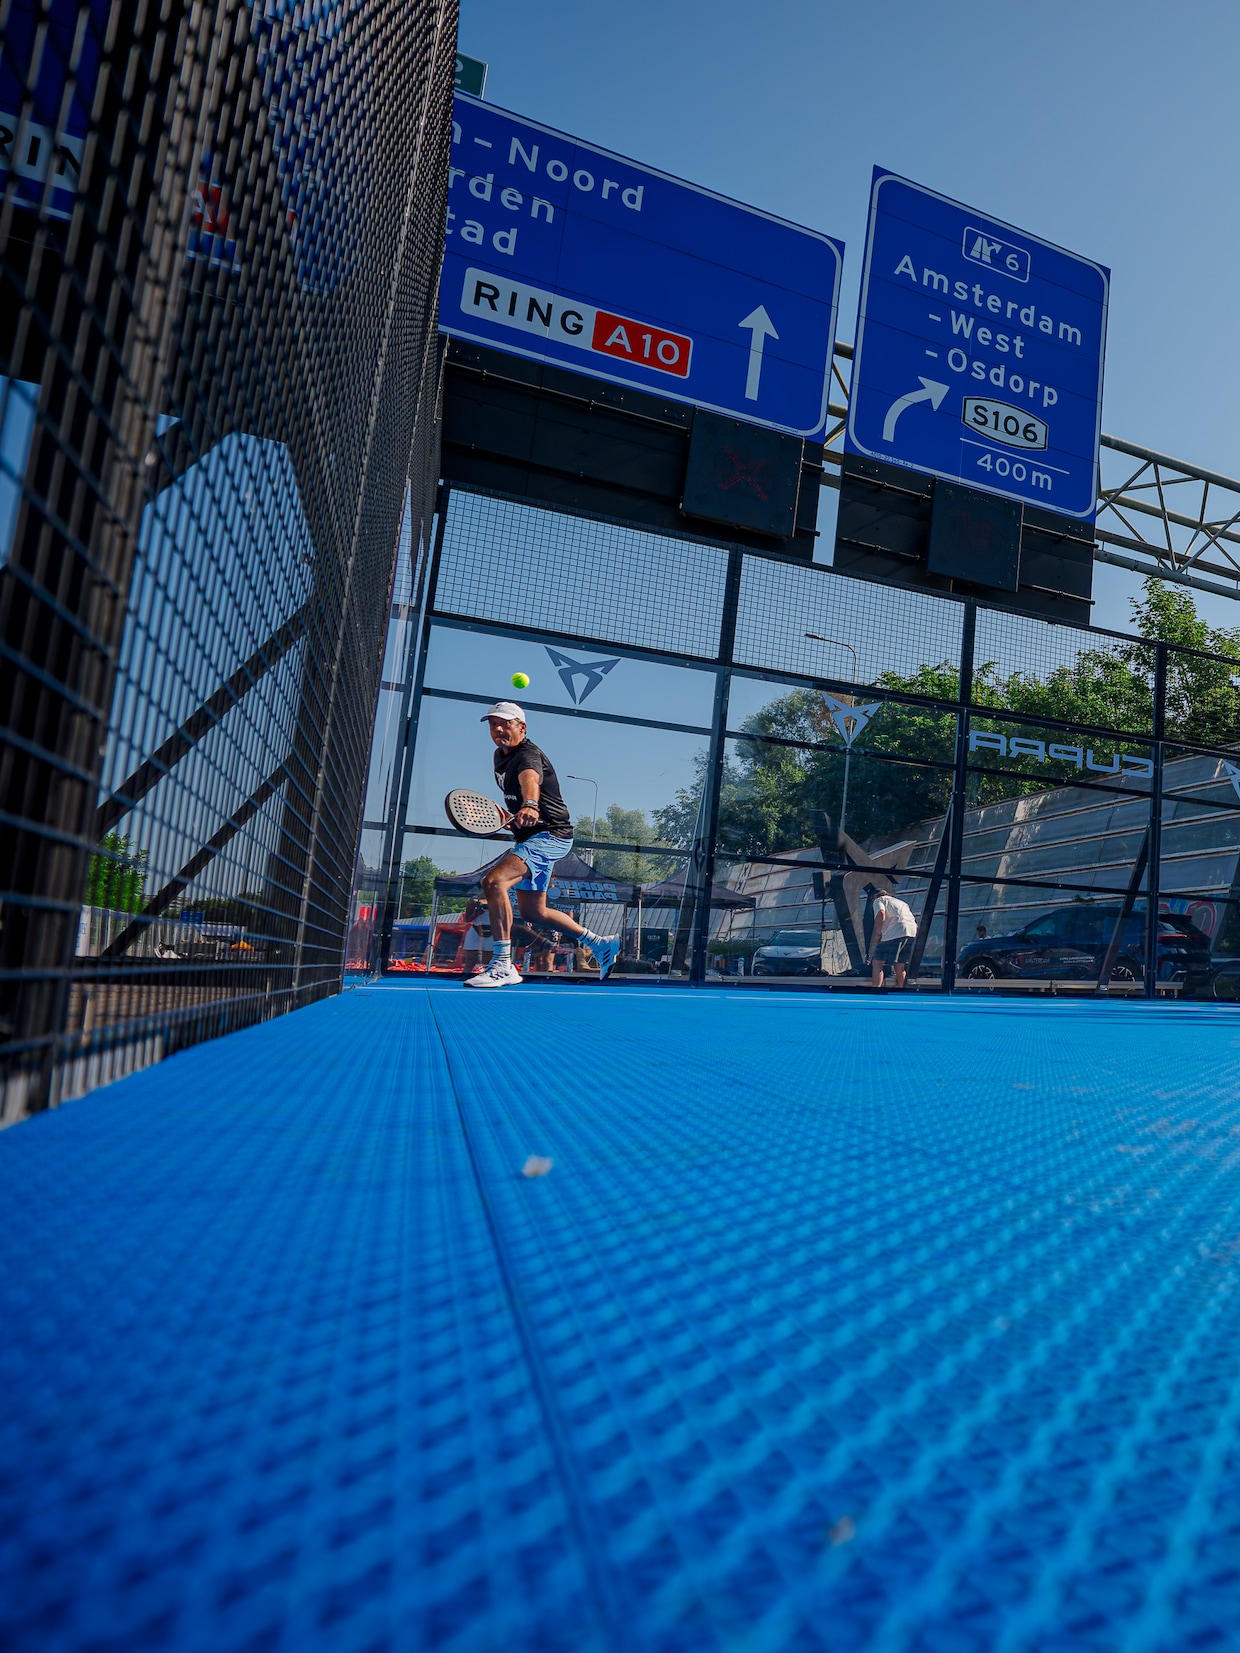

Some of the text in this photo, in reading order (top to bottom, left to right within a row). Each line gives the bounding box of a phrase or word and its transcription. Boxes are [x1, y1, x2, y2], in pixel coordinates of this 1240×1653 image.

[1005, 253, 1020, 272] 6
[472, 280, 680, 365] RING A10
[894, 254, 1083, 346] Amsterdam
[971, 404, 1038, 443] S106
